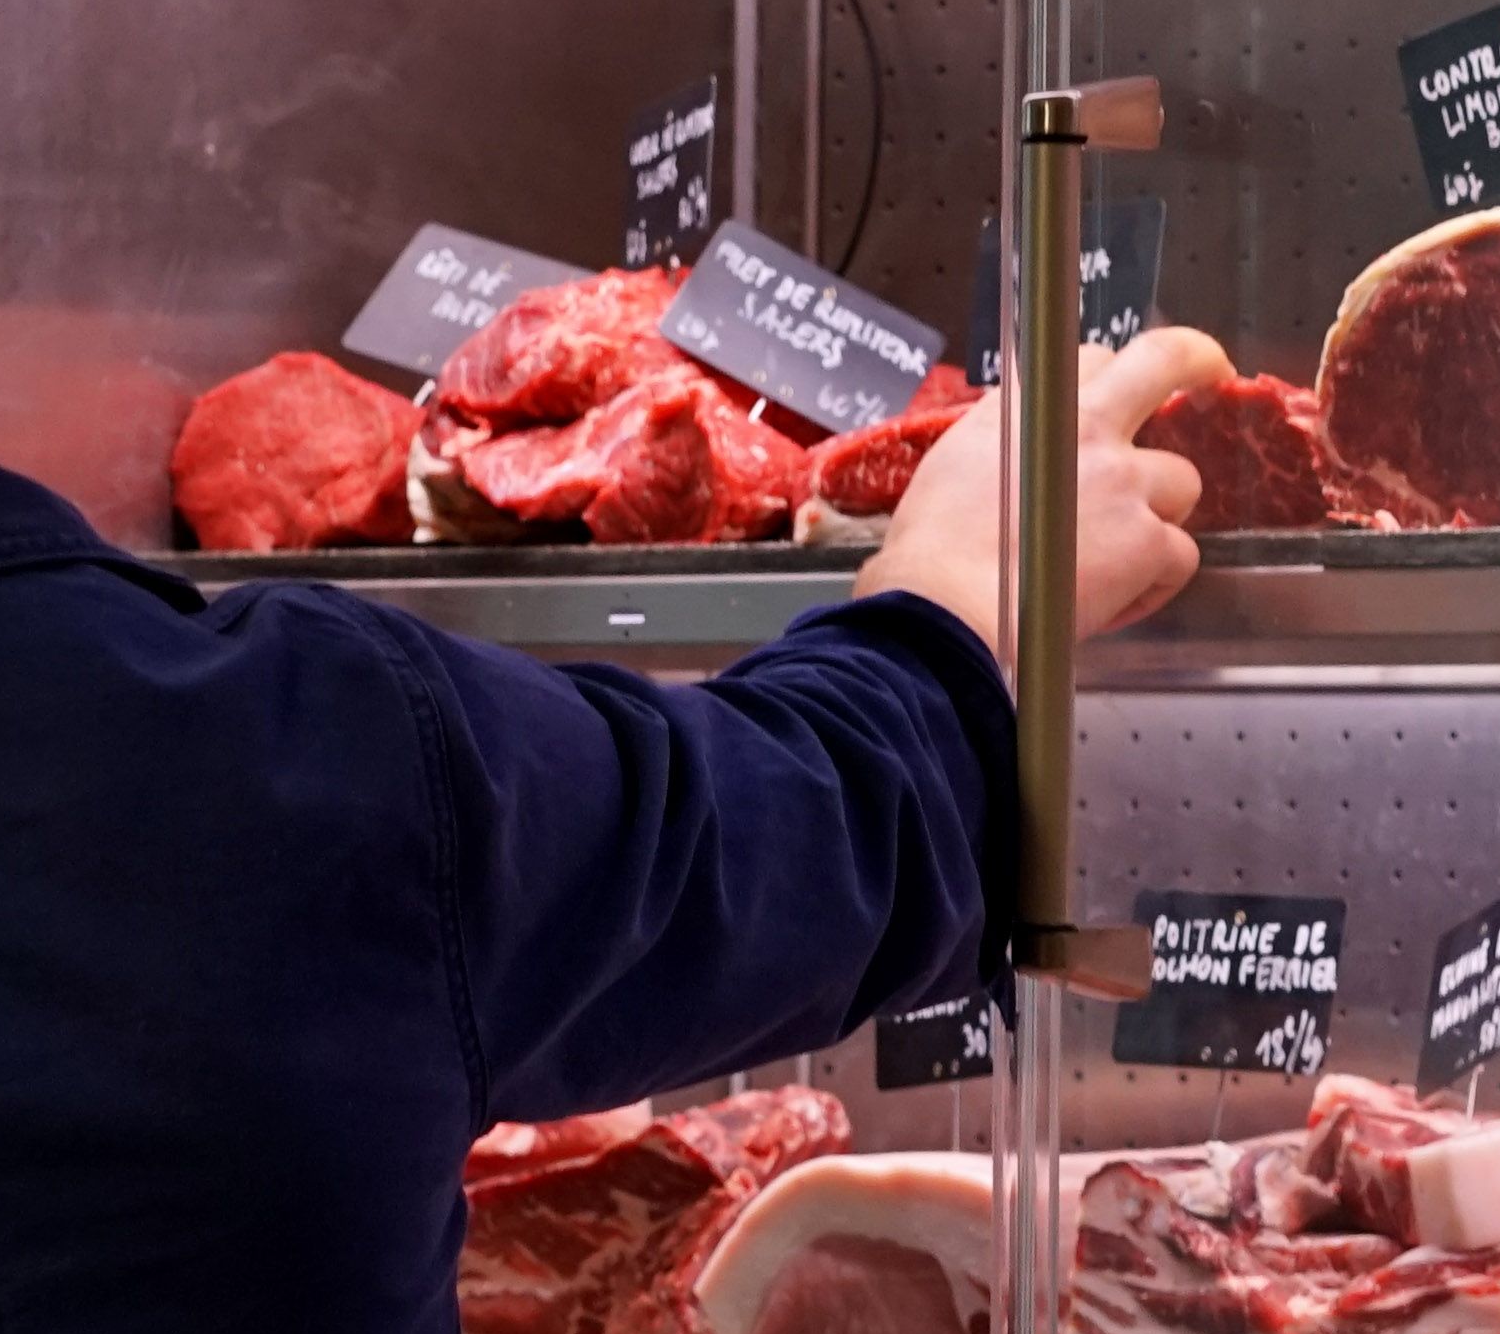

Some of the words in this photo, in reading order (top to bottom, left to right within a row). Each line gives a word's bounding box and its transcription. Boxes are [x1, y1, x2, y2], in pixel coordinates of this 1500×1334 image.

[775, 276, 815, 311] DE
[1152, 913, 1281, 955] POITRINE
[1294, 920, 1327, 955] DE
[1238, 954, 1338, 993] FERMIER
